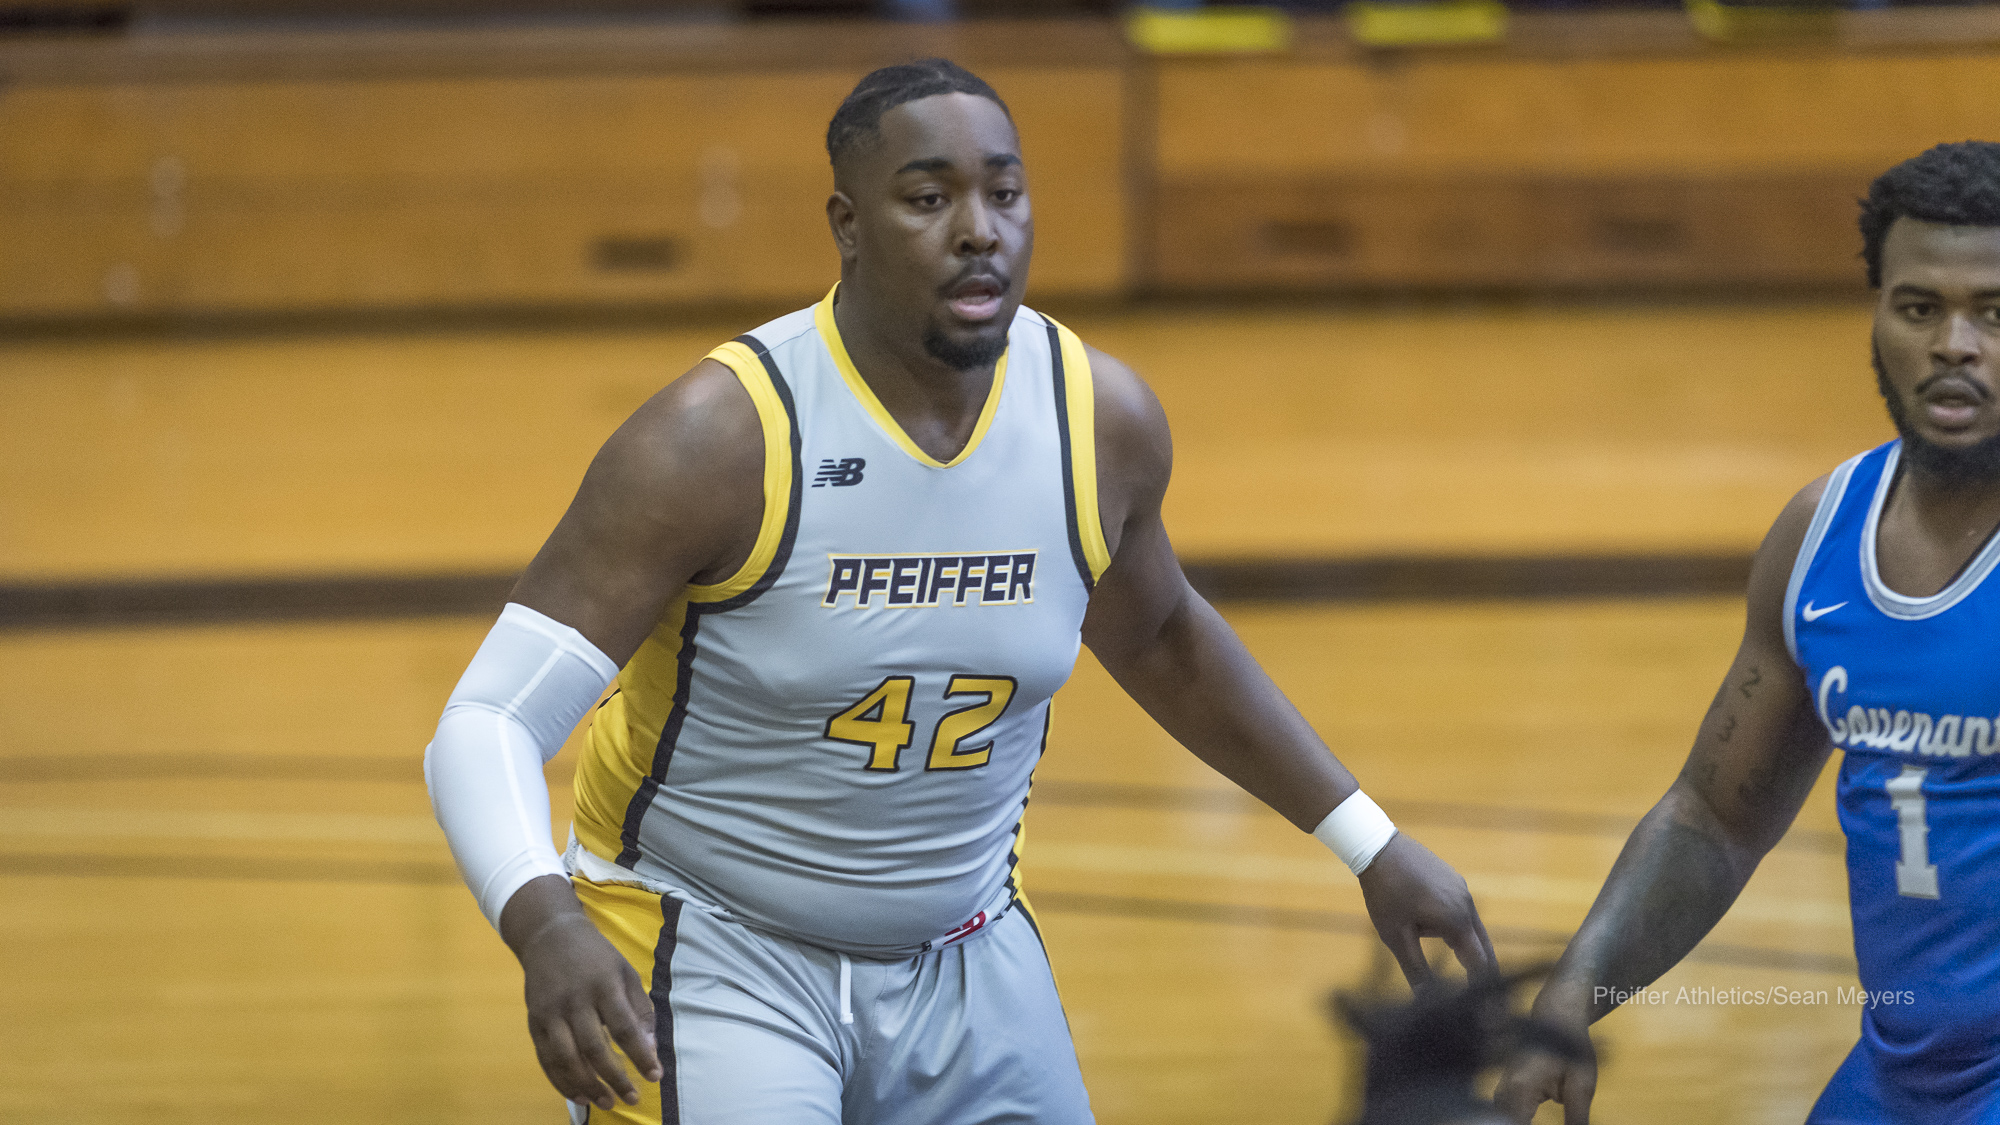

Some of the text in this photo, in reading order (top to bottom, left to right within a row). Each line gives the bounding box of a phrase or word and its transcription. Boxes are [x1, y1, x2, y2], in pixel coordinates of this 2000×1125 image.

[811, 457, 866, 487] NB
[821, 549, 1039, 608] PFEIFFER
[823, 674, 1018, 772] 42
[1885, 763, 1940, 900] 1
